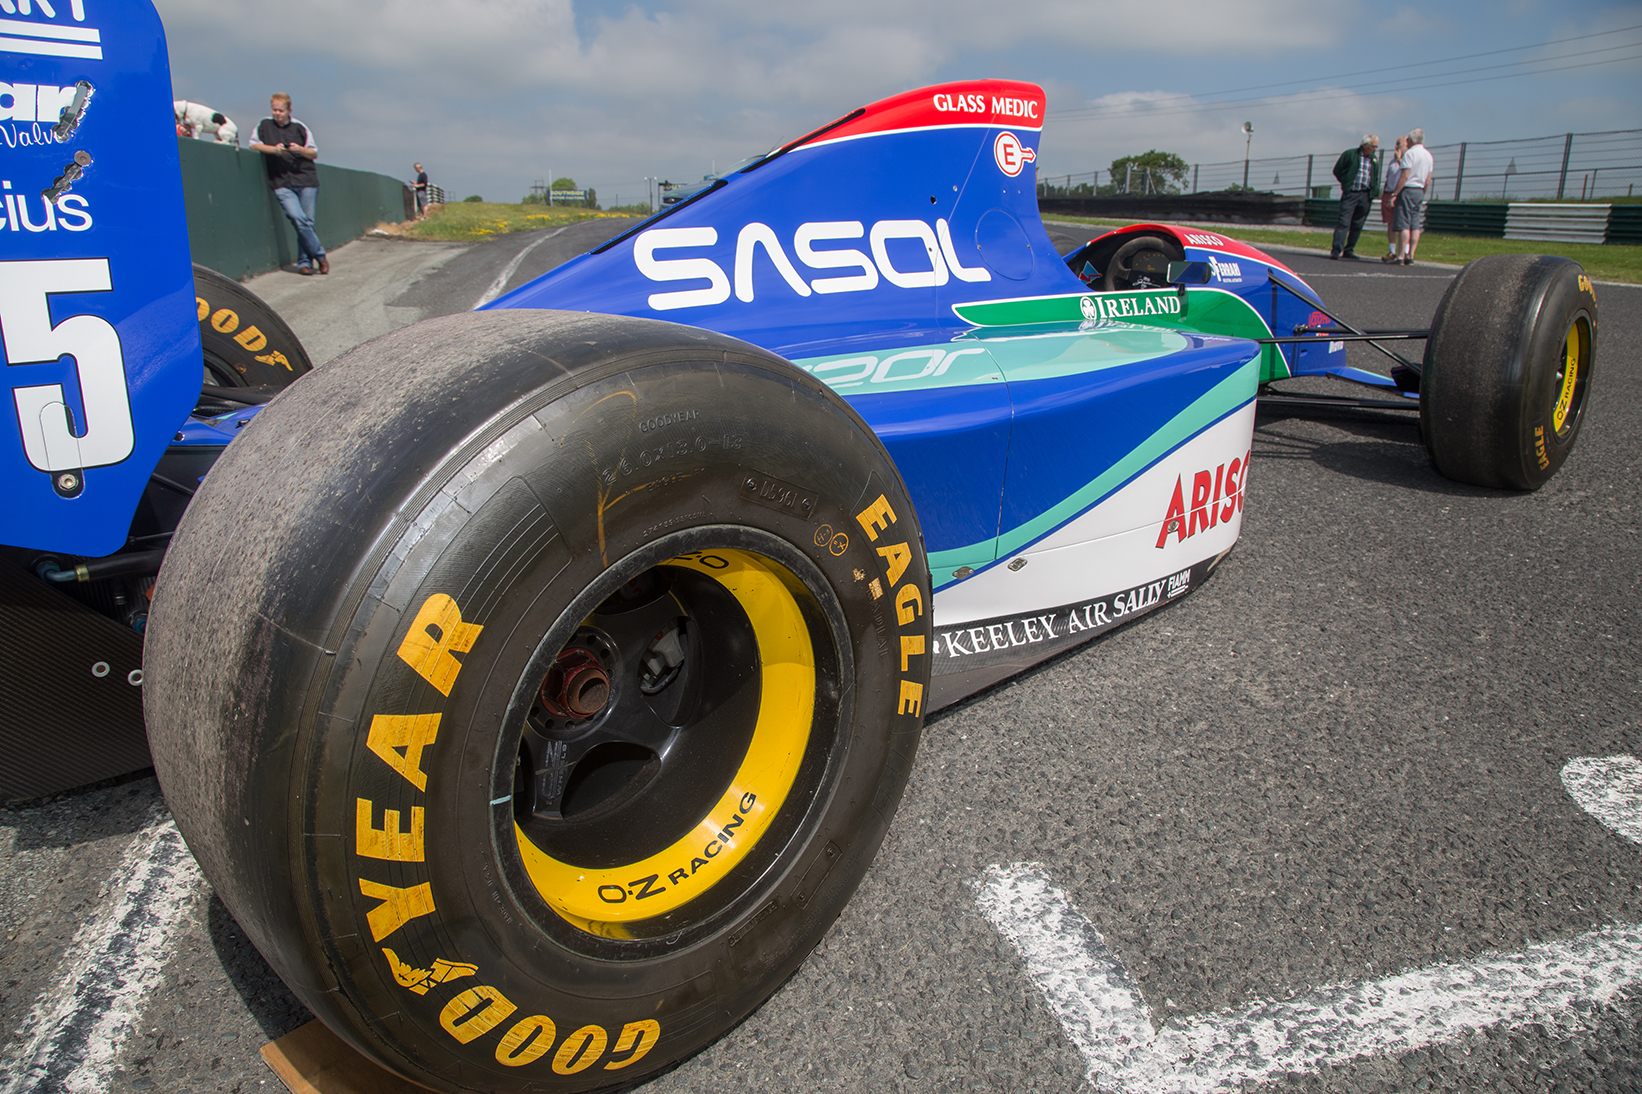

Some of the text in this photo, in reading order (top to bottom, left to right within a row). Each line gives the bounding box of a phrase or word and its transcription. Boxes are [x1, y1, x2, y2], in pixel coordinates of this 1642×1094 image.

[933, 94, 1038, 119] GLASS MEDIC
[1003, 143, 1016, 165] E
[634, 218, 991, 311] SASOL
[1095, 296, 1181, 318] IRELAND
[0, 257, 136, 475] 5
[639, 410, 701, 433] GOODYEAR
[1535, 425, 1550, 471] EAGLE
[1113, 579, 1167, 618] SALLY
[1168, 569, 1192, 592] FIAMM
[855, 494, 926, 719] EAGLE
[941, 602, 1112, 657] KEELEY AIR
[667, 791, 757, 886] RACING
